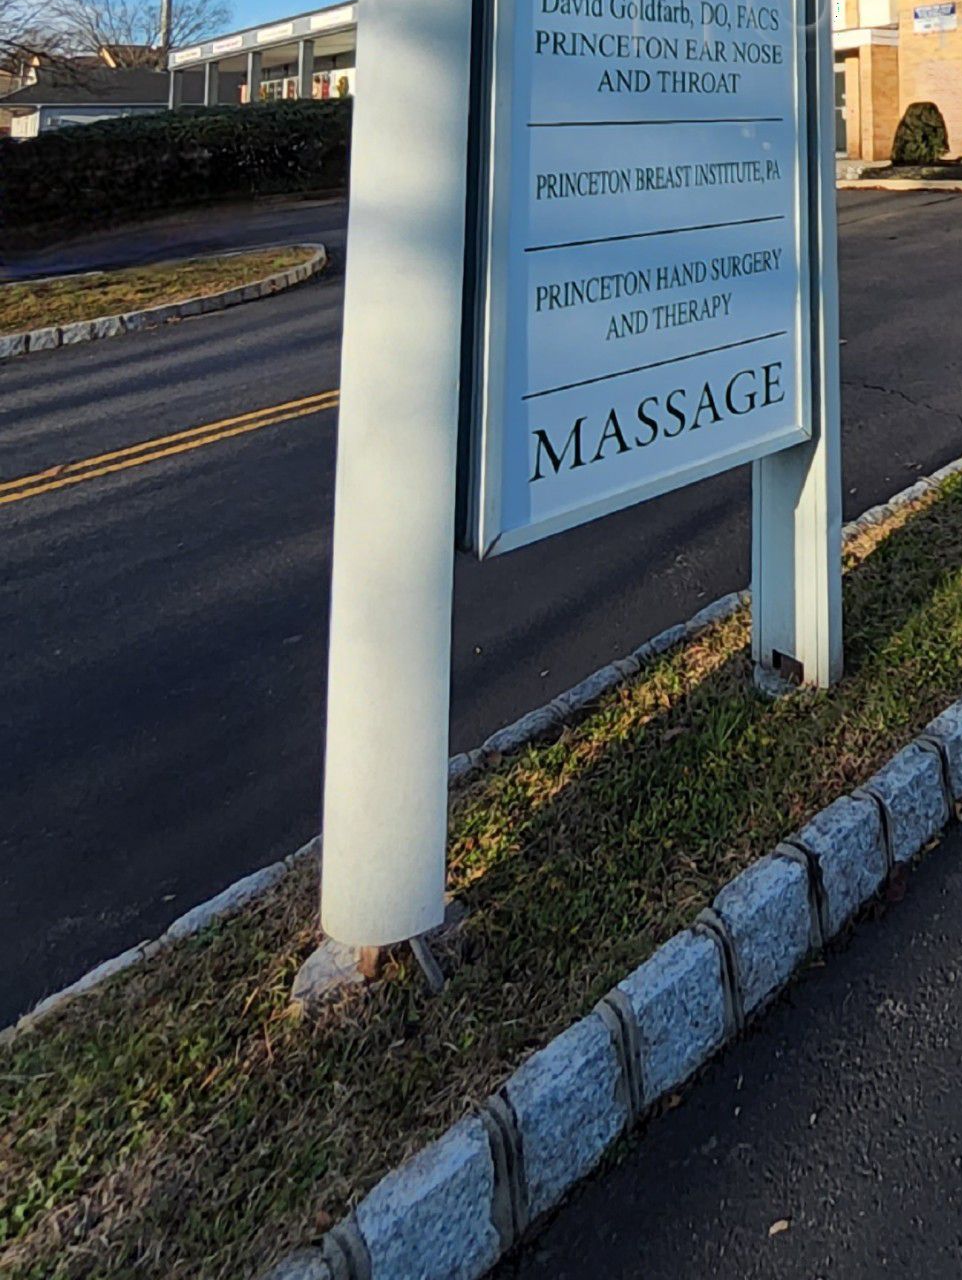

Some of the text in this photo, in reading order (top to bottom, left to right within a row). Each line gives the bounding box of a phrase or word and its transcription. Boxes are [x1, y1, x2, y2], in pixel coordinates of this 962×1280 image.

[701, 1, 731, 32] DO,
[737, 4, 779, 32] FACS
[535, 30, 783, 65] PRINCETON EAR NOSE
[597, 69, 741, 94] AND THROAT
[536, 160, 781, 200] PRINCETON BREAST INSTITUTE, PA
[535, 248, 783, 312] PRINCETON HAND SURGERY
[605, 293, 732, 341] AND THERAPY
[528, 361, 786, 483] MASSAGE
